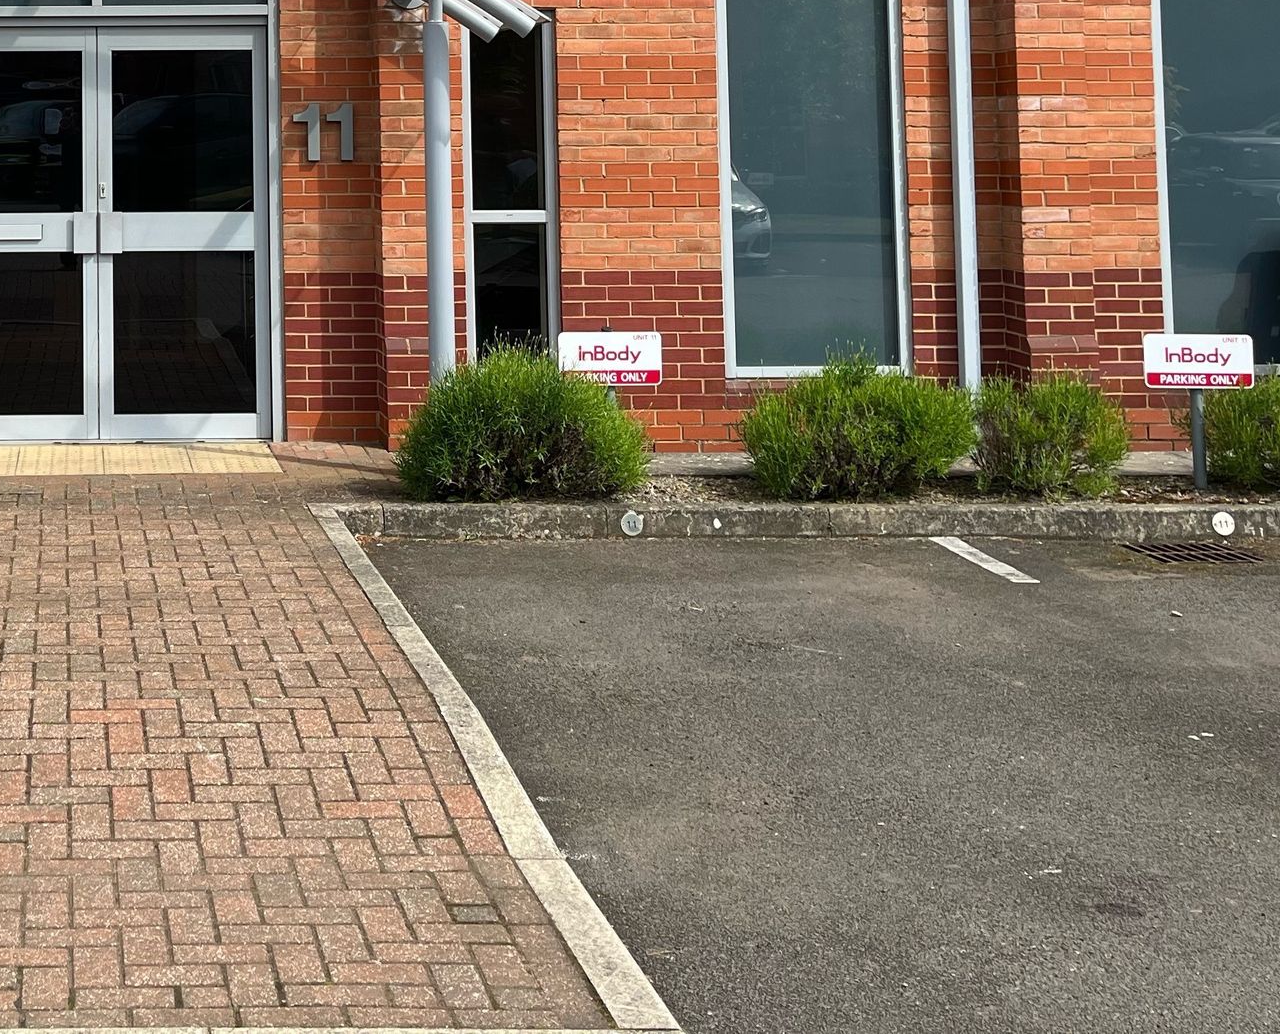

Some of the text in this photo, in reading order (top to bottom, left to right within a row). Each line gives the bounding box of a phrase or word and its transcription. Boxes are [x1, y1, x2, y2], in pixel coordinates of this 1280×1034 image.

[292, 102, 354, 161] 11
[1164, 347, 1232, 367] InBody
[620, 372, 648, 382] ONLY
[1160, 374, 1239, 385] PARKING ONLY
[627, 520, 637, 528] 11
[1219, 520, 1229, 528] 11
